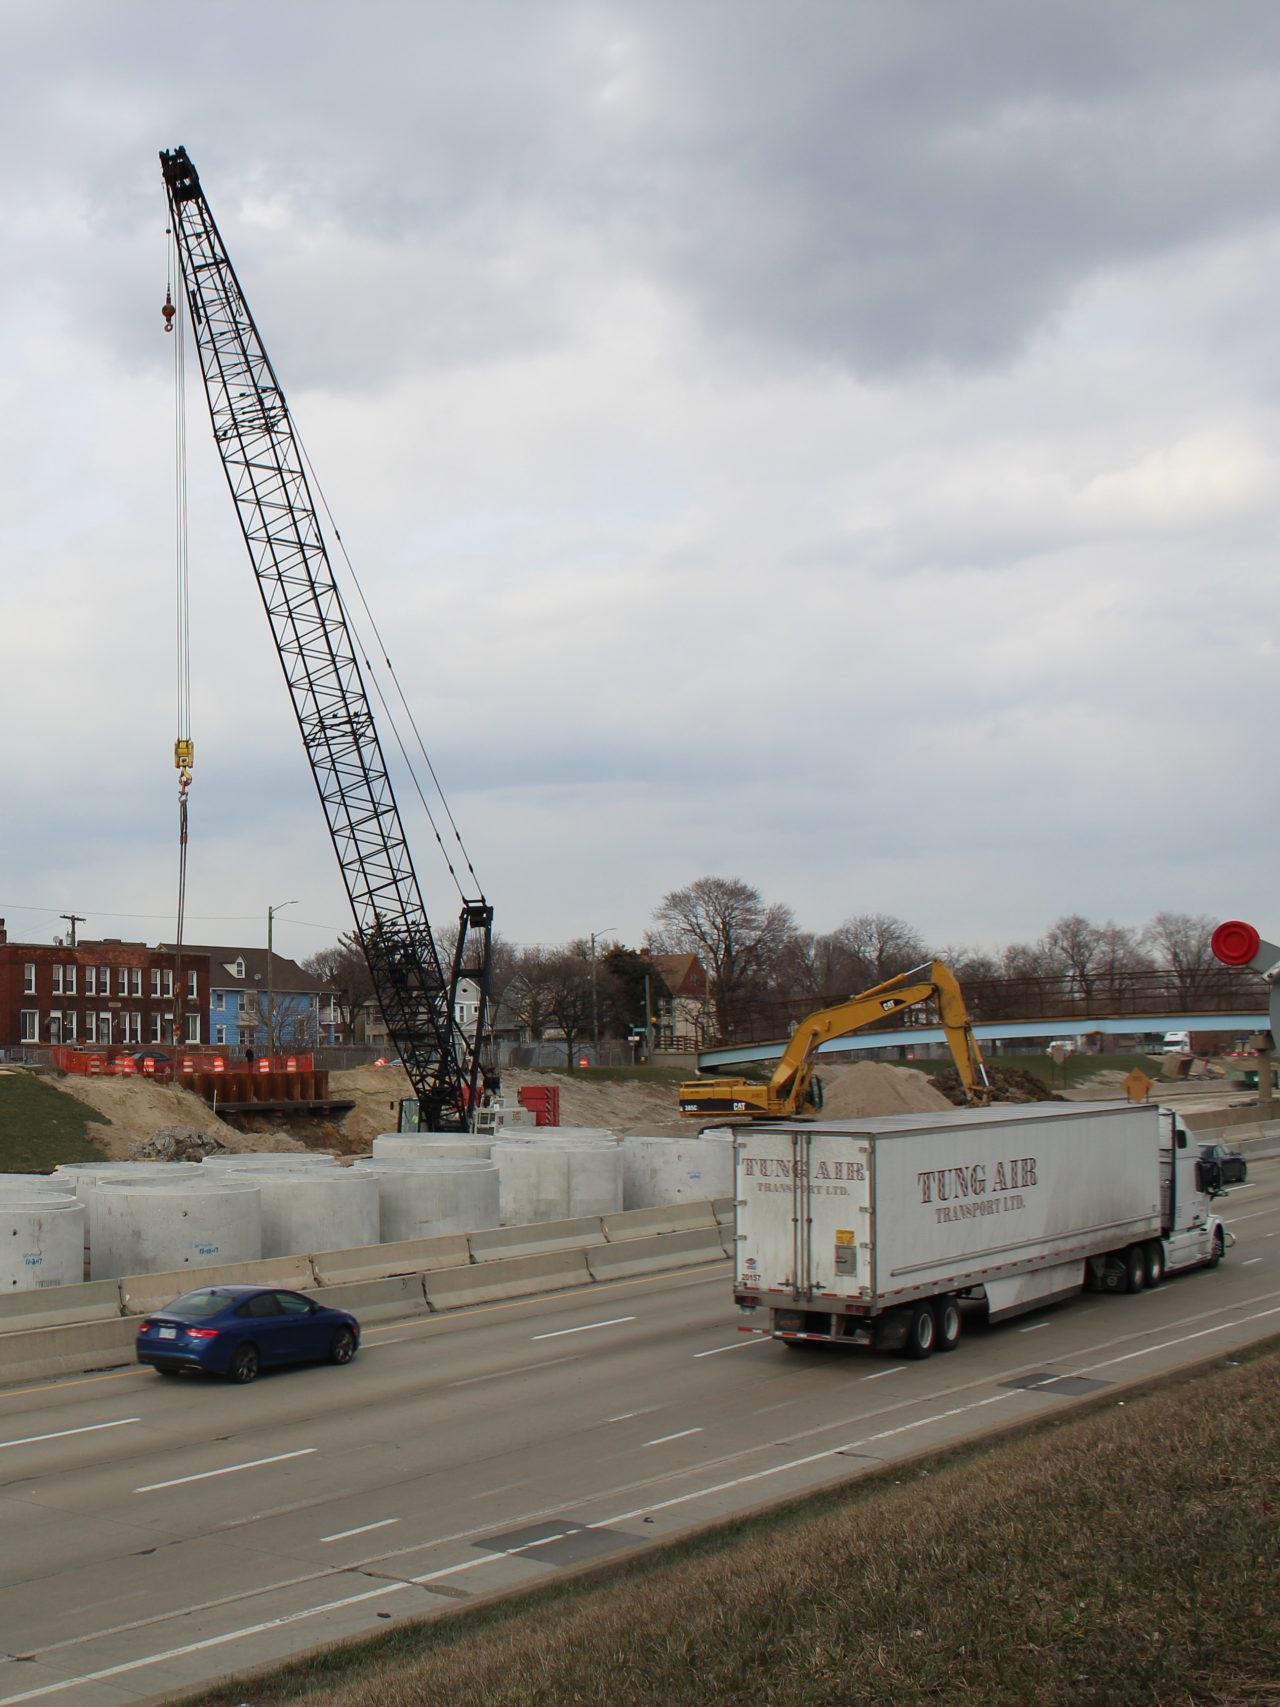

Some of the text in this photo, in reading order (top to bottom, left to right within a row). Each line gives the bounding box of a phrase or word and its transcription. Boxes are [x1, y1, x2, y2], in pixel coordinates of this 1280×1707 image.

[883, 1000, 895, 1010] CAT
[733, 1103, 746, 1111] CAT
[814, 1161, 865, 1181] AIR
[918, 1157, 1038, 1204] TUNG AIR
[935, 1194, 1026, 1224] TRANSPORT LTD.
[741, 1273, 761, 1282] 20157
